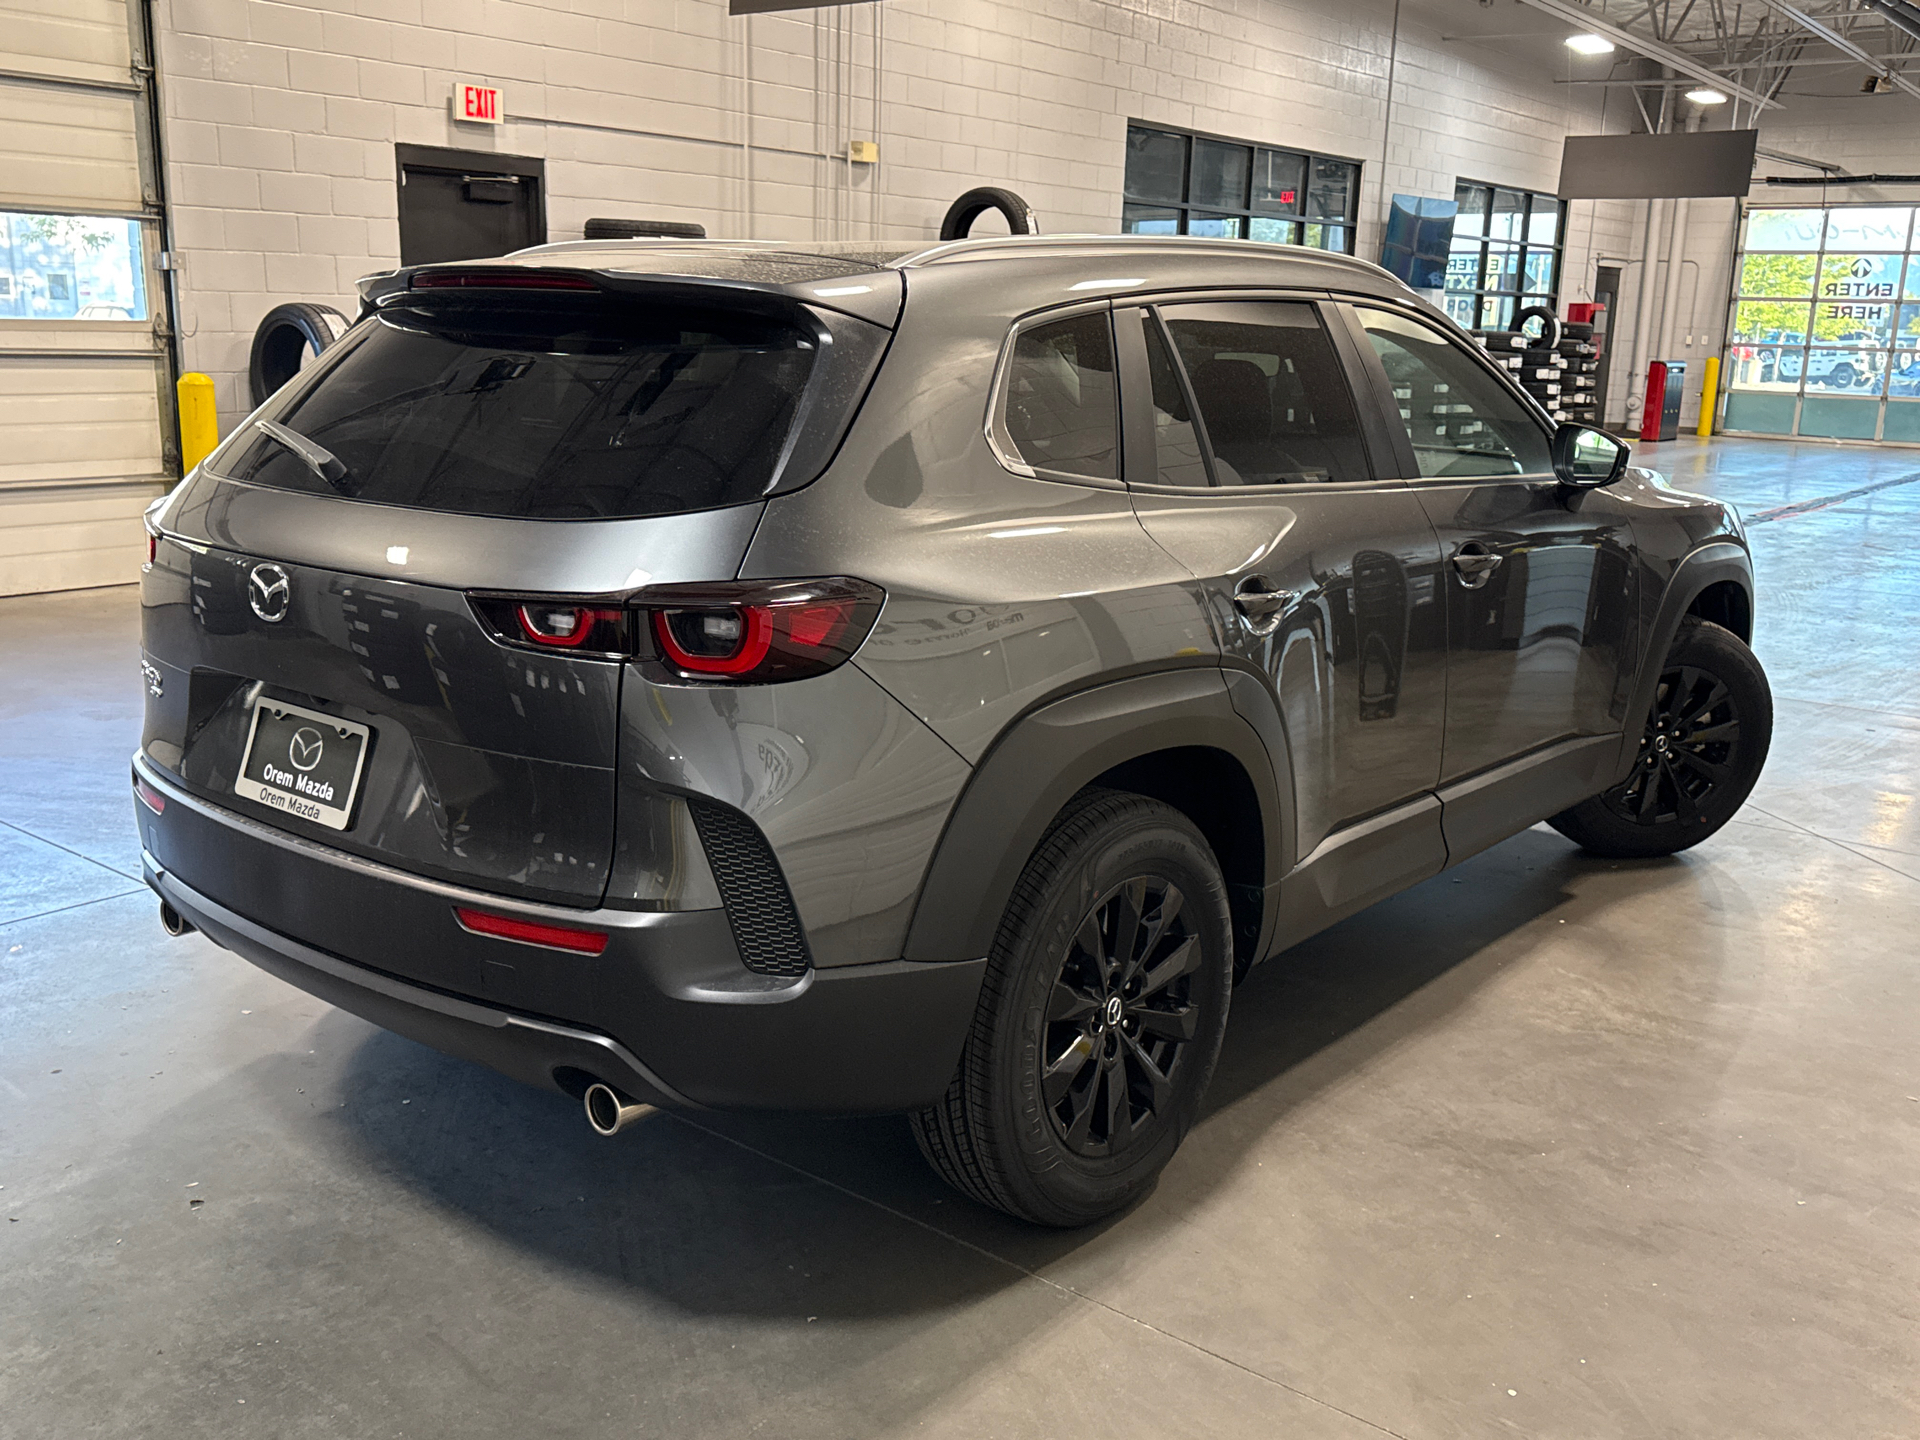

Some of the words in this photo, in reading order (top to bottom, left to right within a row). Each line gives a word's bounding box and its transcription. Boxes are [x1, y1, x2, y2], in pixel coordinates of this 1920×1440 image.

[465, 86, 497, 120] EXIT
[263, 763, 294, 788] Orem
[295, 773, 334, 801] Mazda
[260, 788, 285, 807] Orem
[287, 797, 320, 819] Mazda
